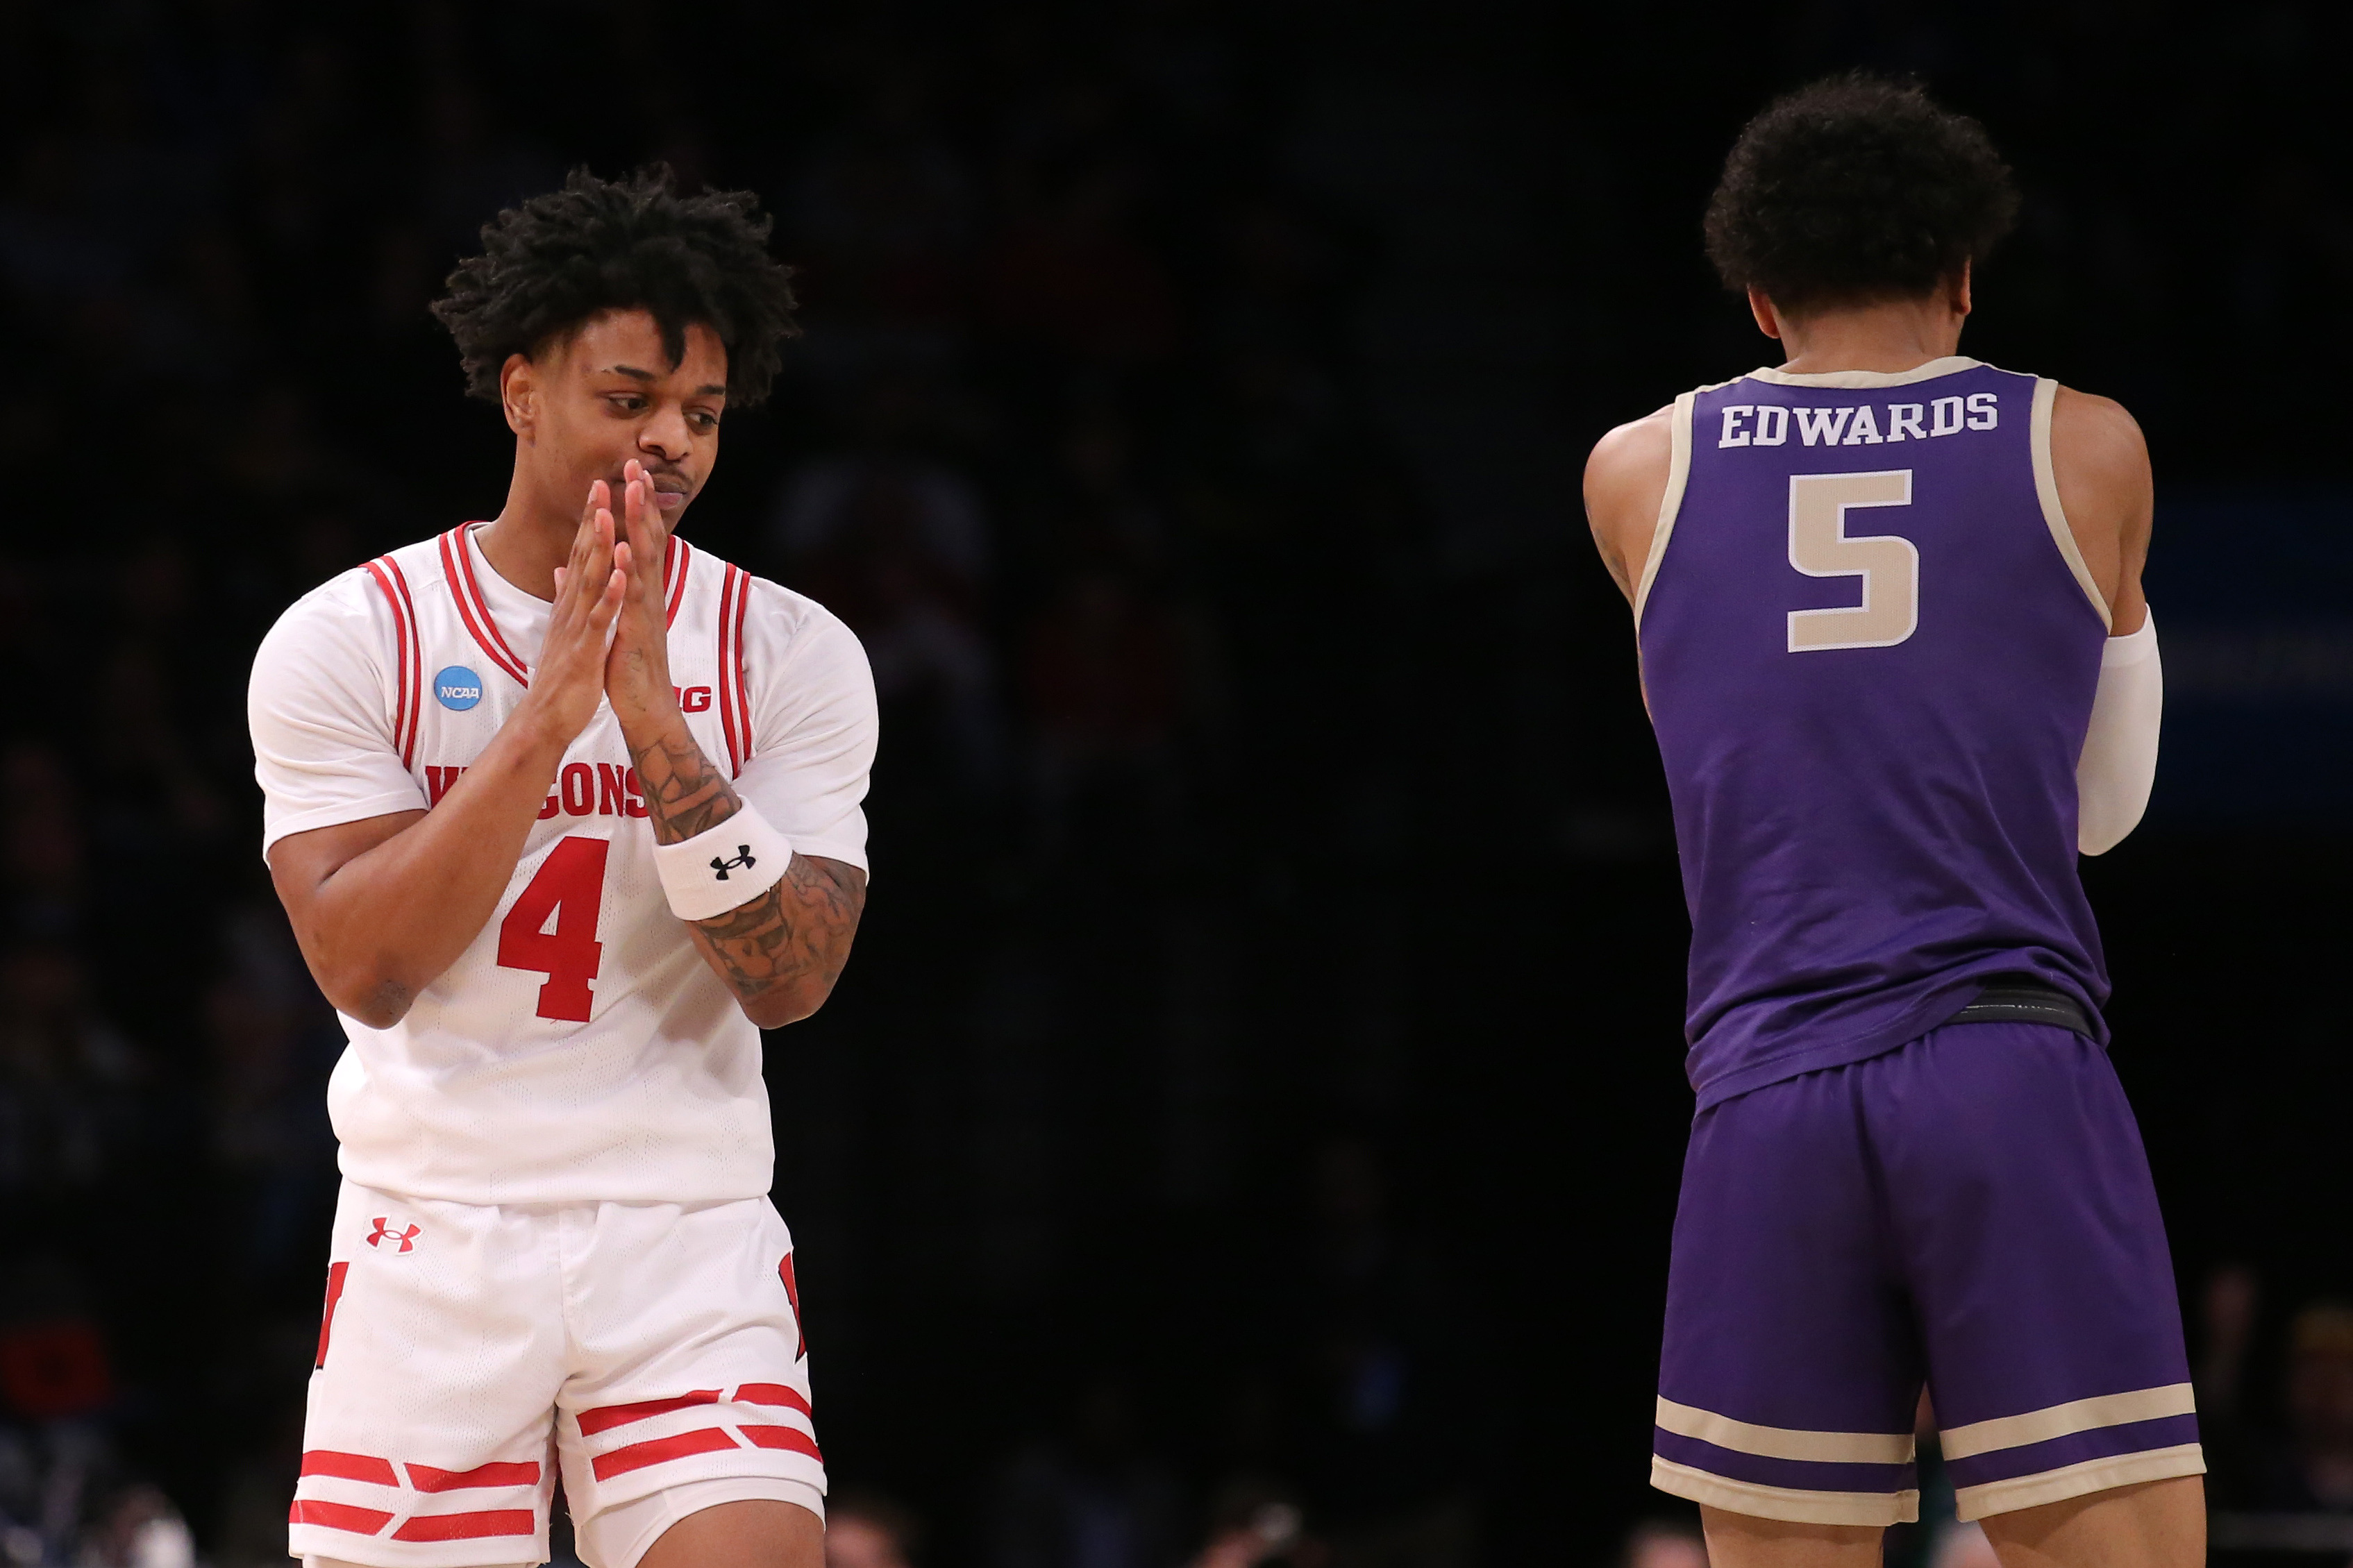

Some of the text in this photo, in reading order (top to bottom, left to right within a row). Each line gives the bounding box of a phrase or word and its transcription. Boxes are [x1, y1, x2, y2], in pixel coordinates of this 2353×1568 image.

[1718, 392, 1998, 449] EDWARDS
[1786, 469, 1920, 653] 5
[441, 686, 479, 699] NCAA
[496, 836, 610, 1023] 4
